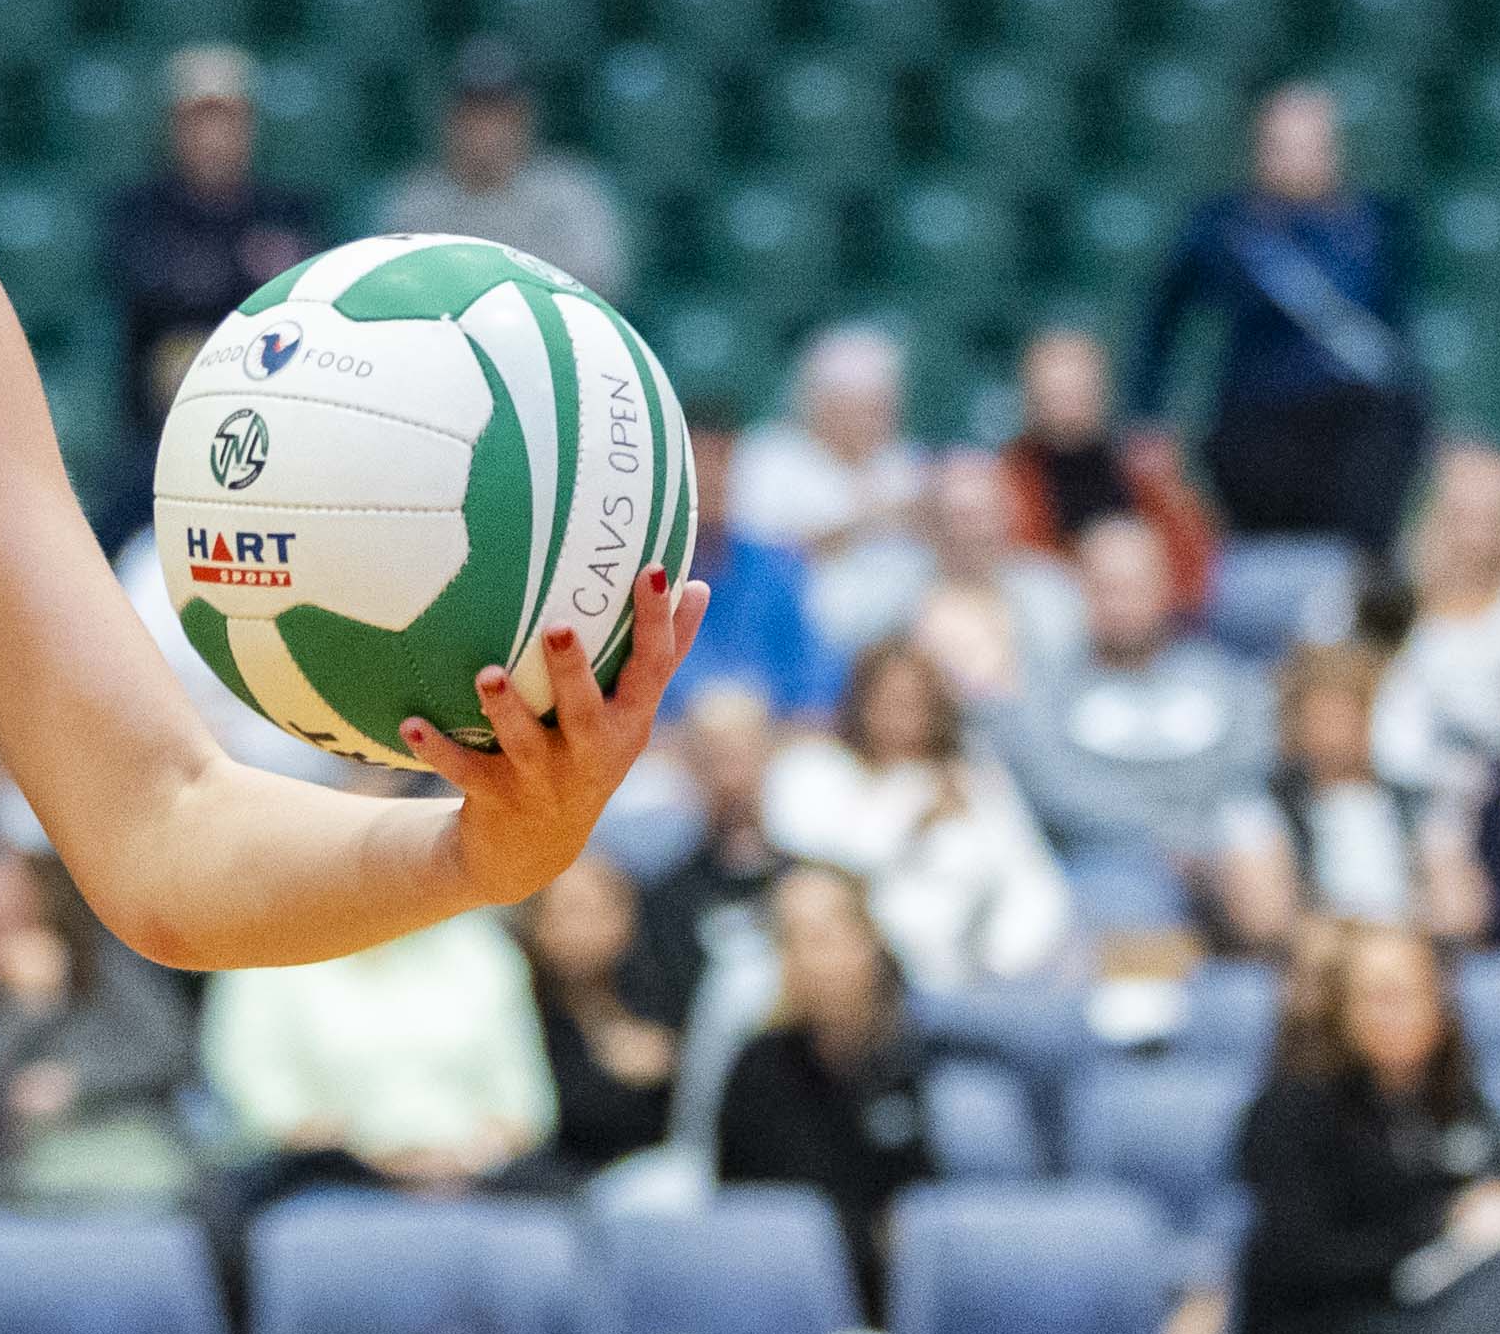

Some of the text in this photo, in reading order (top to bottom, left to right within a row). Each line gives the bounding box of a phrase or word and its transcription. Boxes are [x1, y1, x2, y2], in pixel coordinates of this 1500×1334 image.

[302, 348, 375, 378] FOOD
[572, 373, 640, 617] CAVS OPEN
[187, 527, 296, 564] HART
[219, 569, 288, 586] SPORT
